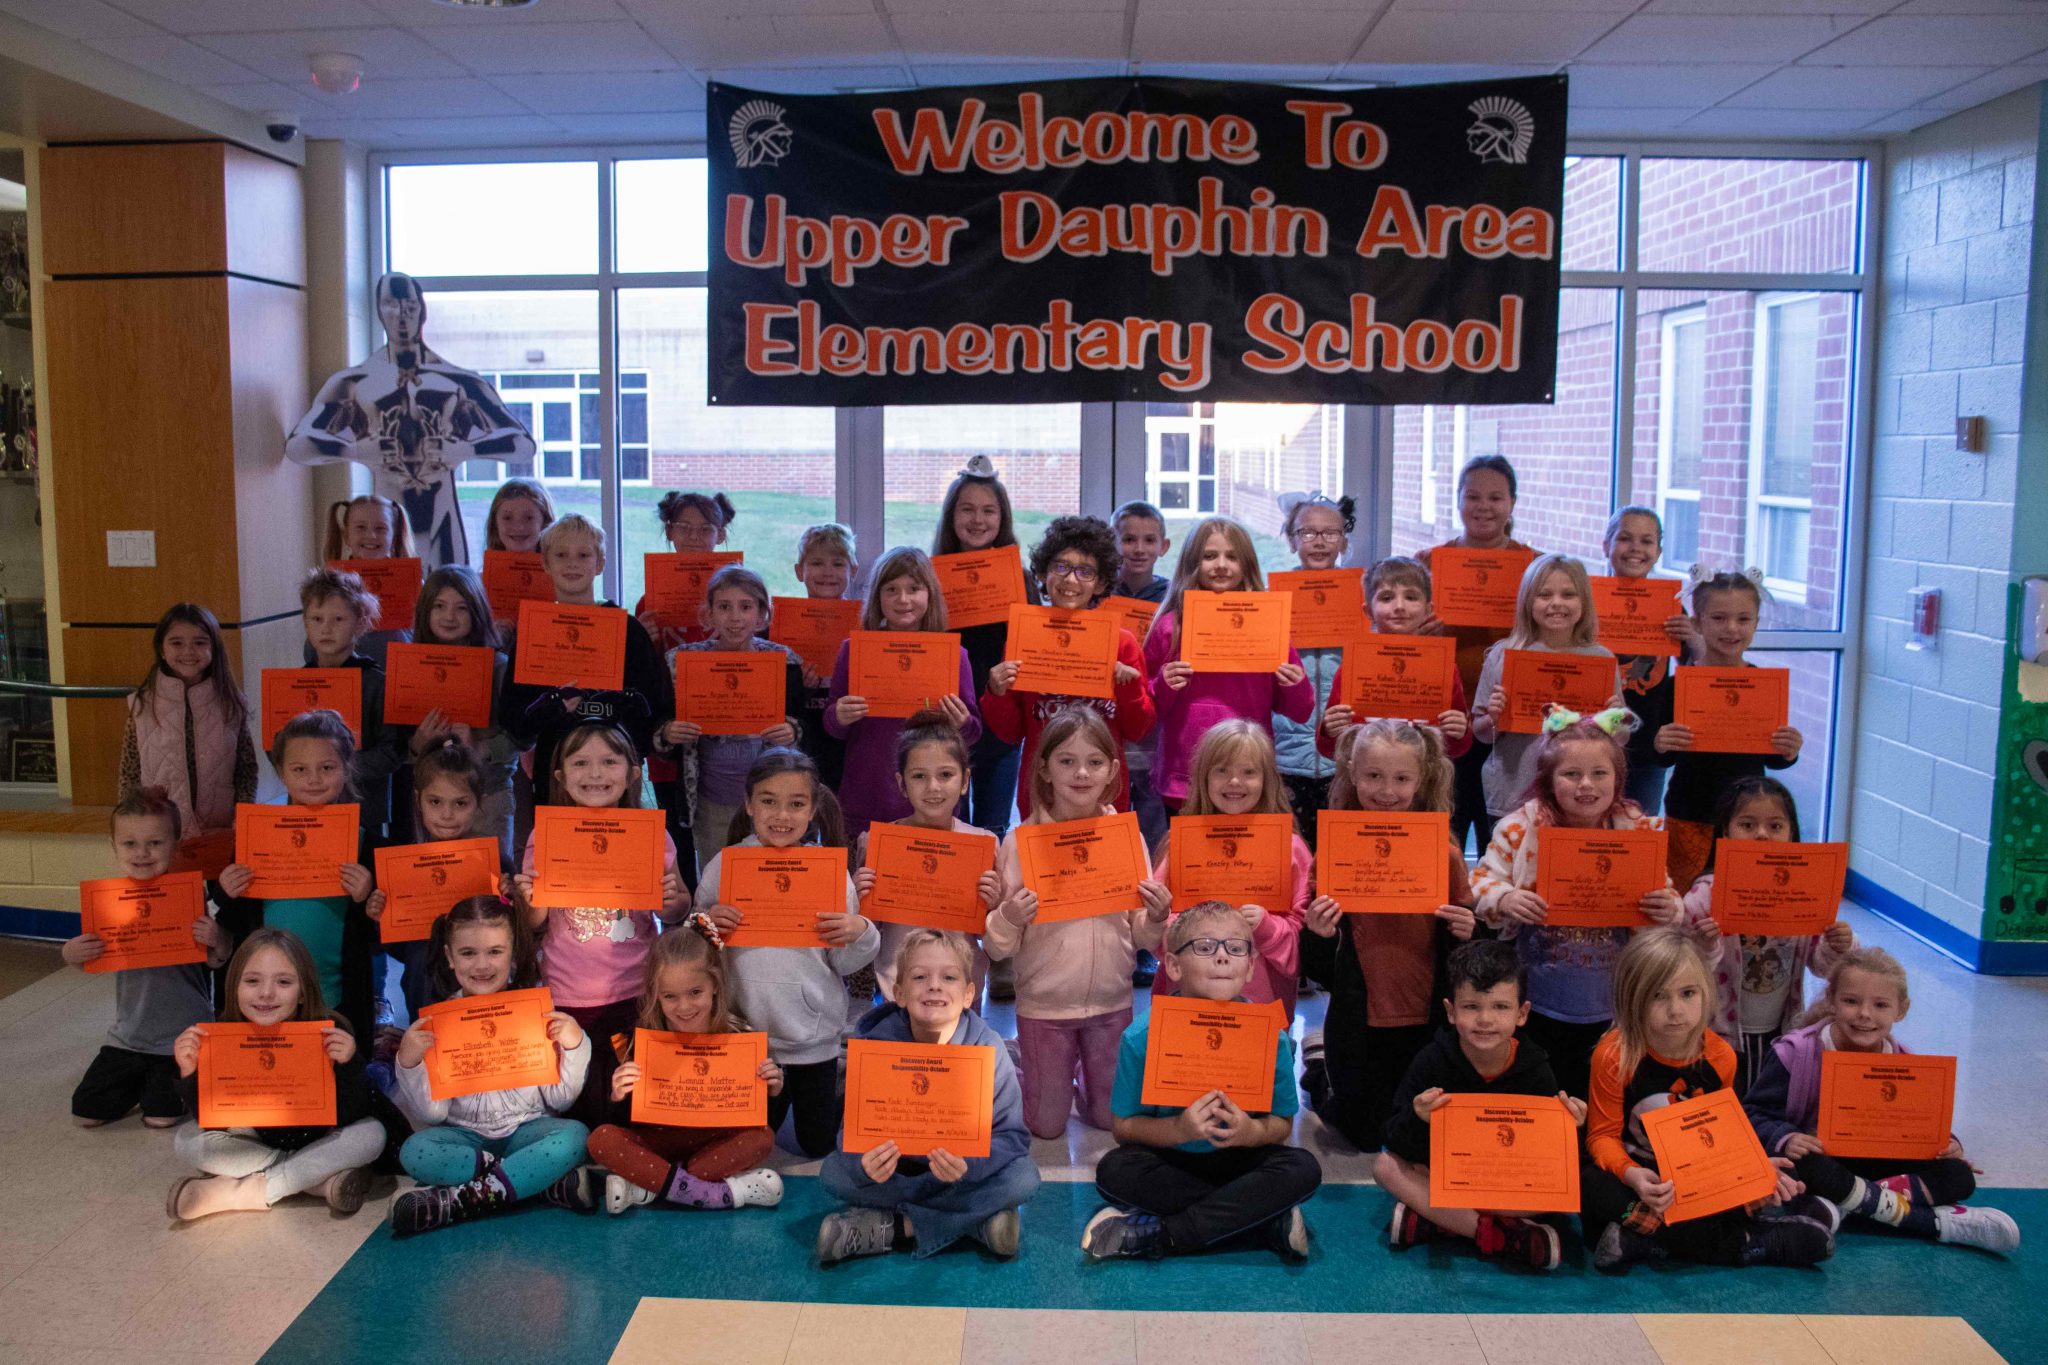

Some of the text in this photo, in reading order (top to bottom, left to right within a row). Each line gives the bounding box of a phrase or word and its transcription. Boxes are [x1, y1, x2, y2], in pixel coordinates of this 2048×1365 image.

[872, 92, 1388, 176] Welcome To
[725, 177, 1554, 287] Upper Dauphin Area
[742, 292, 1523, 392] Elementary School
